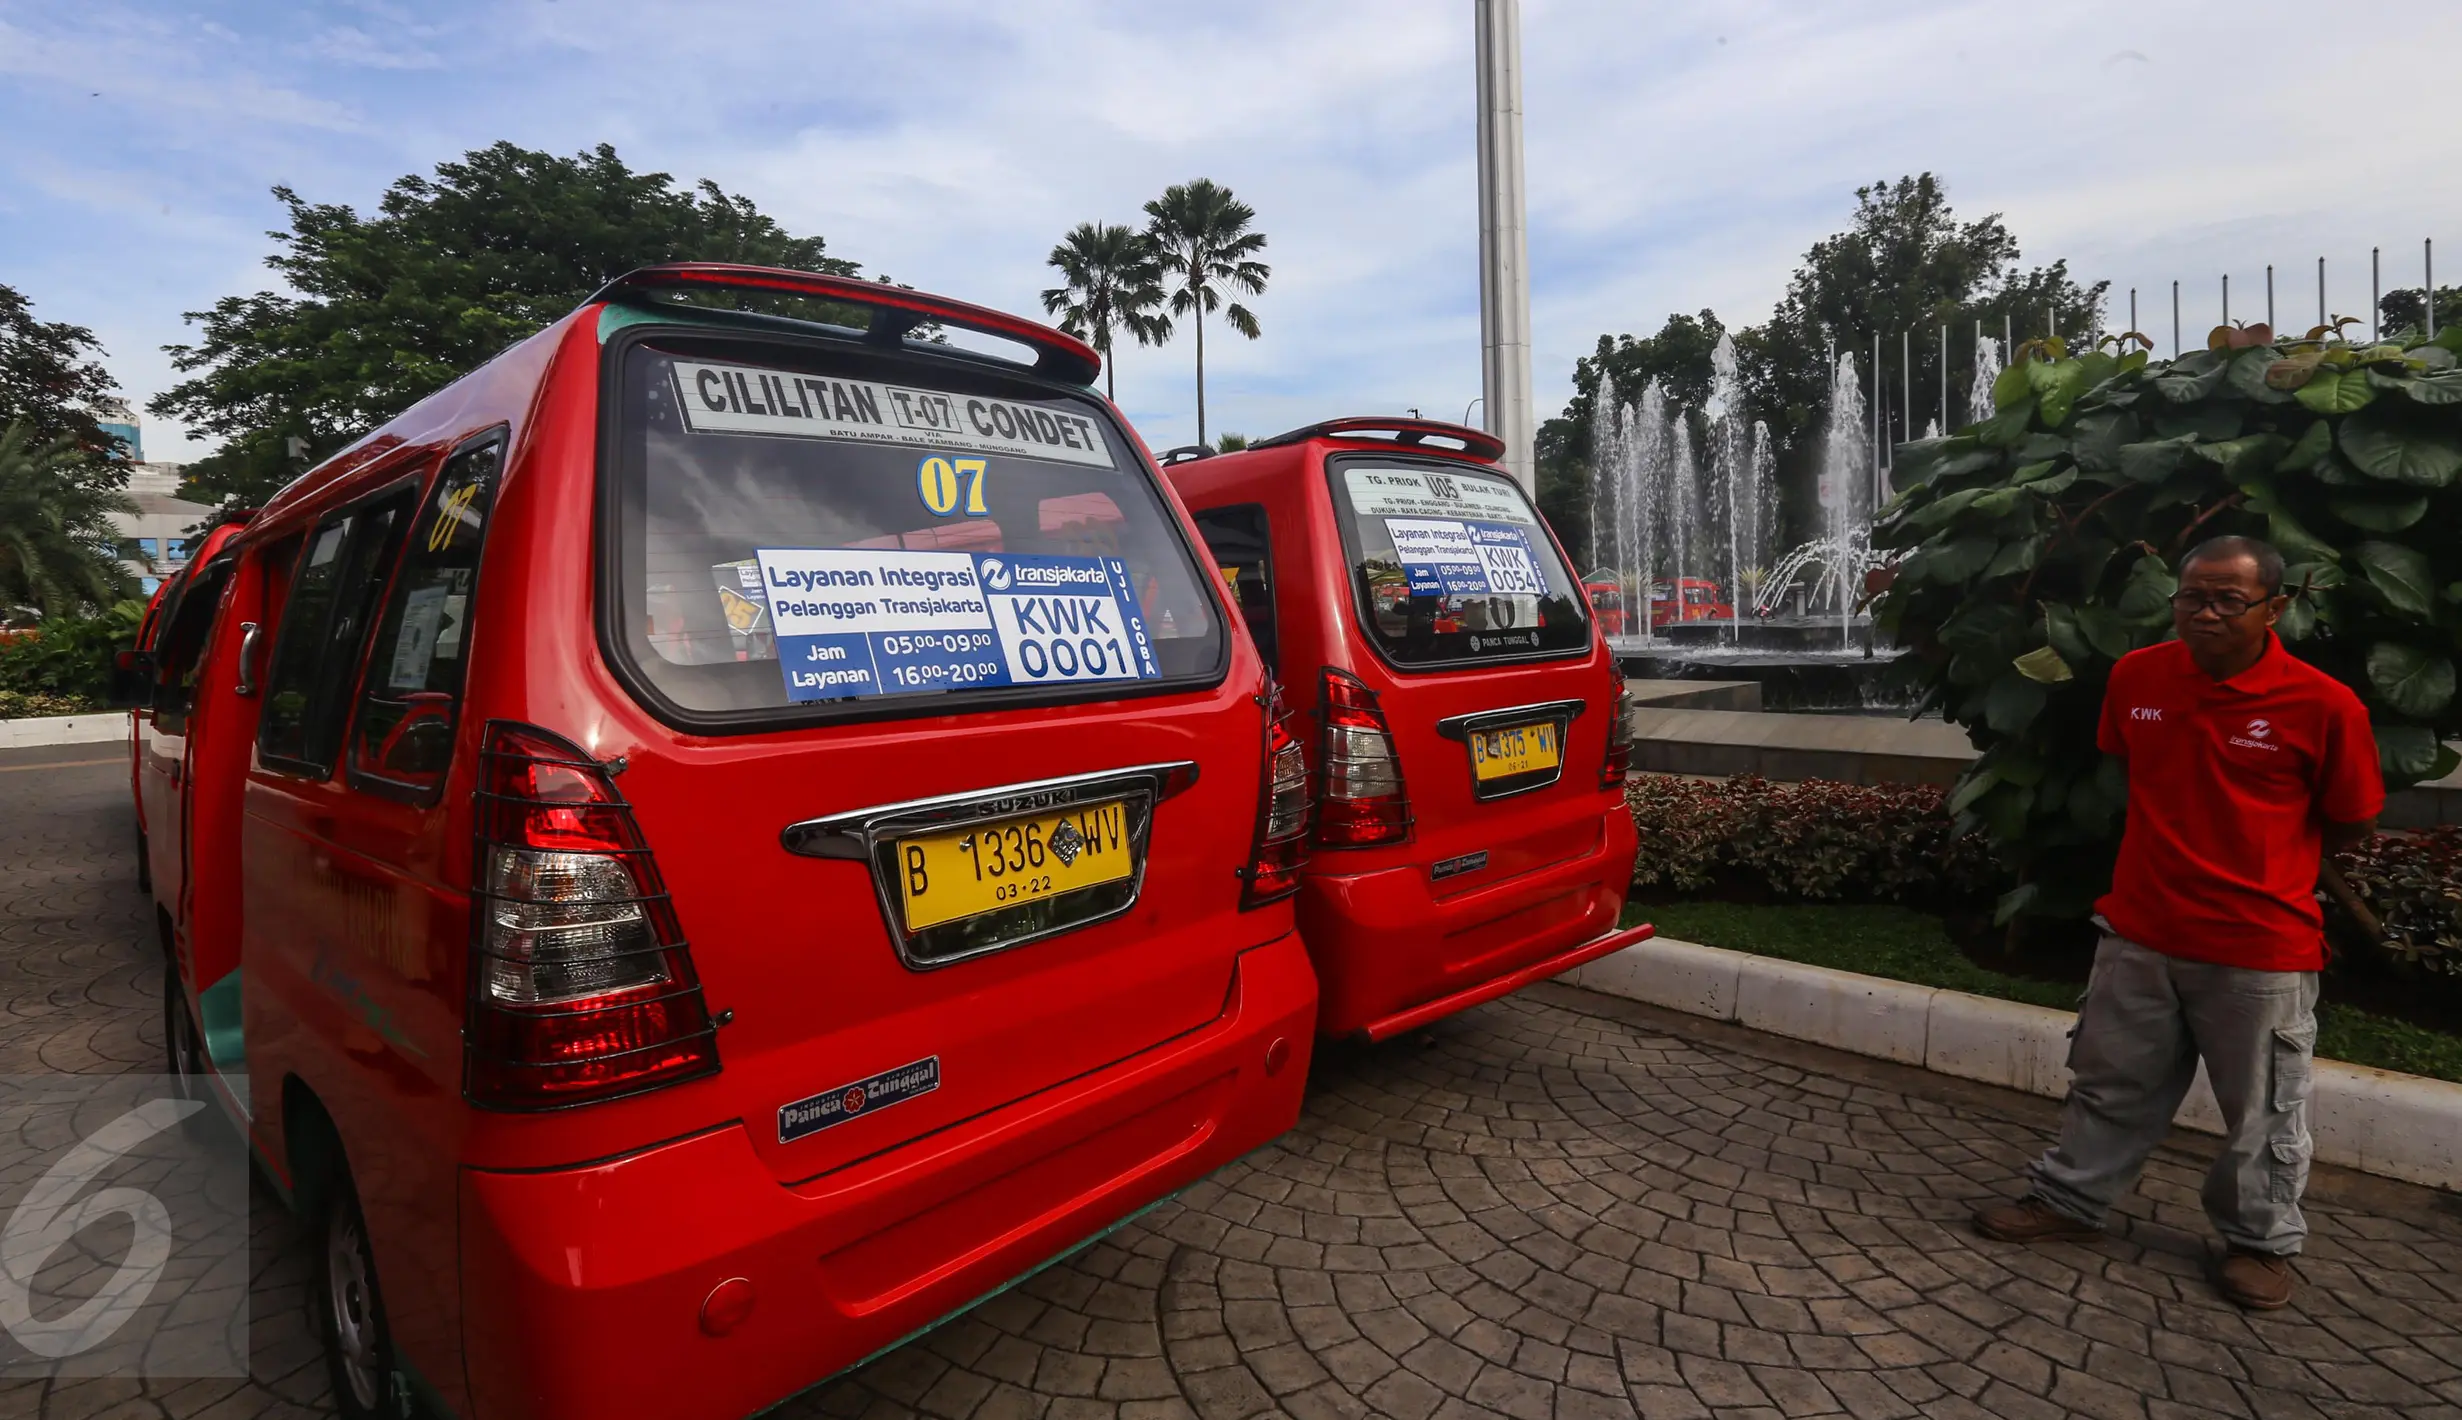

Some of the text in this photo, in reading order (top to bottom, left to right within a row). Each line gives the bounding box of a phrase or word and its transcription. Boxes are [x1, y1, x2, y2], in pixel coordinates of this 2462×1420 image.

[696, 369, 883, 425] CILILITAN
[893, 391, 951, 429] T-07
[924, 431, 943, 439] VIA
[966, 399, 1095, 451] CONDET
[829, 429, 857, 438] BATU
[860, 432, 894, 441] AMPAR
[901, 435, 925, 444] BALE
[927, 438, 973, 448] KAMBANG
[917, 455, 991, 516] 07
[1366, 475, 1422, 488] TG. PRIOK
[1424, 475, 1460, 500] U05
[1461, 483, 1490, 495] BULAK
[1391, 527, 1468, 542] Layanan Integrasi
[1398, 544, 1475, 556] Pelanggan Transjakarta
[1483, 546, 1526, 569] KWK
[769, 566, 976, 593] Layanan Integrasi
[1015, 563, 1105, 586] transjakarta
[1414, 567, 1430, 577] Jam
[1490, 569, 1537, 592] 0054
[1410, 580, 1440, 592] Layanan
[776, 597, 985, 620] Pelanggan Transjakarta
[1011, 597, 1111, 636] KWK
[1110, 560, 1156, 675] UJI COBA
[806, 644, 847, 662] Jam
[1482, 637, 1502, 648] PANCA
[1019, 638, 1127, 679] 0001
[792, 668, 871, 690] Layanan
[2130, 707, 2162, 721] KWK
[1475, 735, 1485, 764] B
[1537, 725, 1555, 753] WV
[977, 788, 1078, 816] SUZUKI
[907, 806, 1119, 897] B 1336 WV
[785, 1062, 934, 1129] Panca Tunggal
